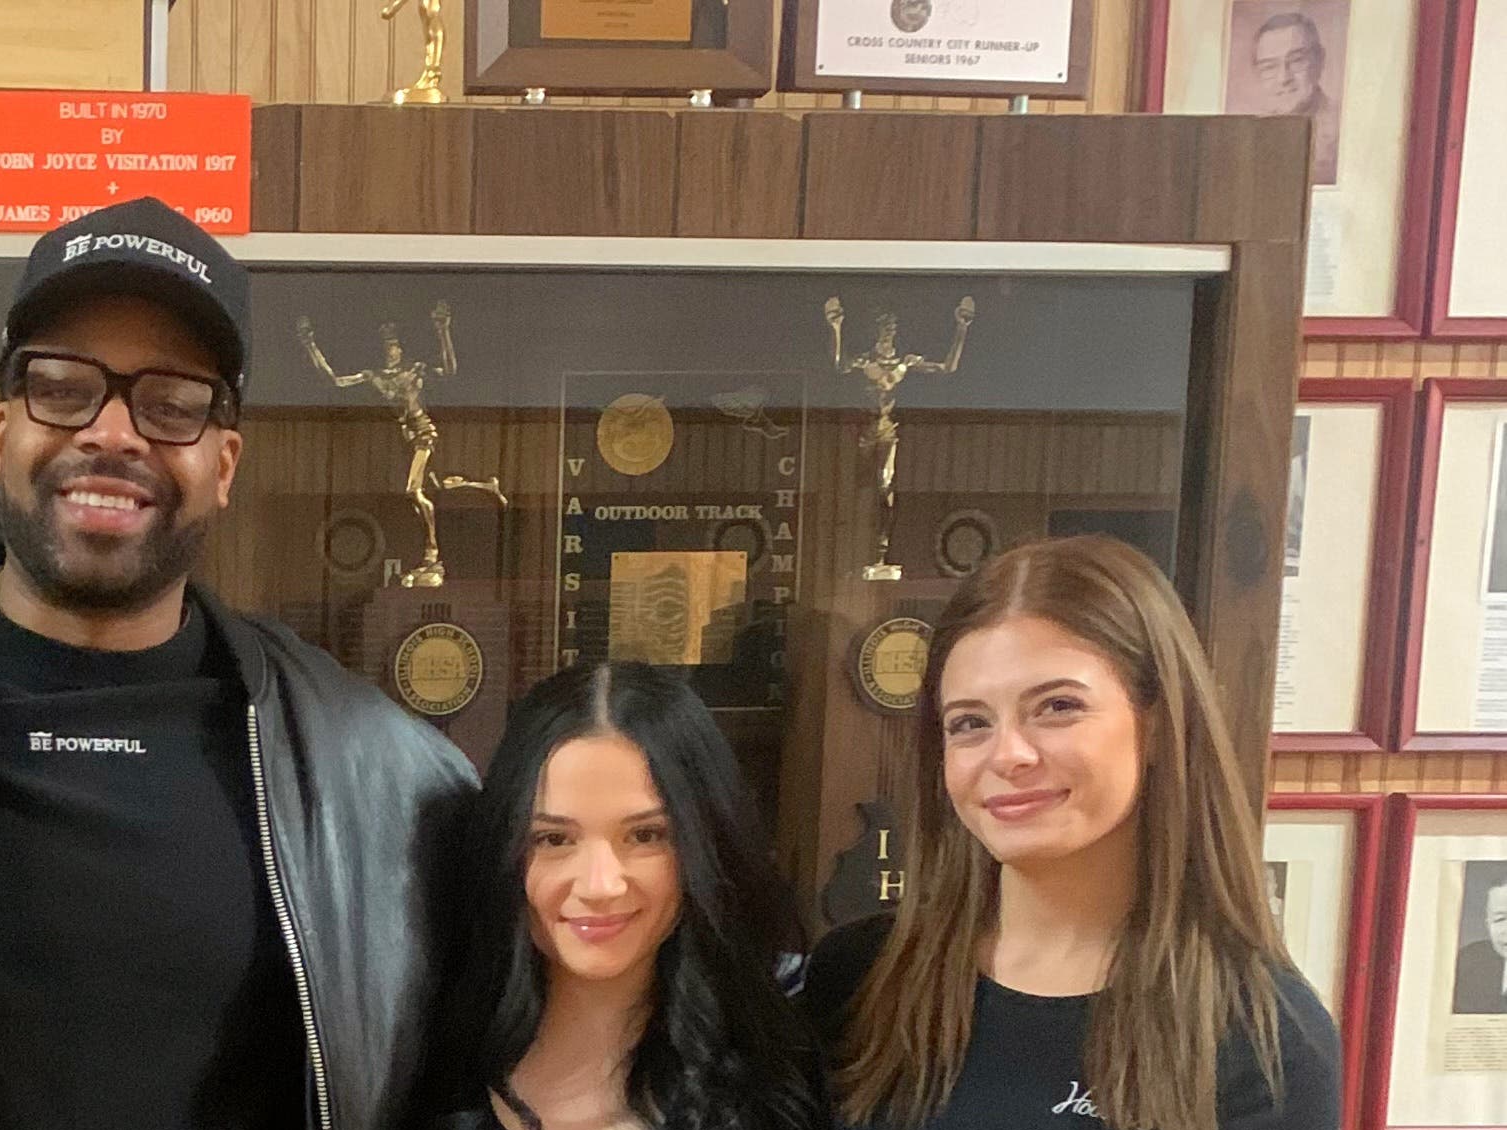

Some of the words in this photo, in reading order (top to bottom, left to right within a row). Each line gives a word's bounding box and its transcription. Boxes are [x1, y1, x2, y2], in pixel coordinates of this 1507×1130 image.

[847, 36, 884, 48] CROSS
[888, 37, 942, 49] COUNTRY
[947, 39, 970, 50] CITY
[974, 40, 1040, 52] RUNNER-UP
[904, 53, 951, 65] SENIORS
[955, 54, 981, 66] 1967
[59, 101, 108, 119] BUILT
[110, 102, 129, 119] IN
[130, 102, 168, 120] 1970
[100, 127, 124, 145] BY
[42, 153, 97, 170] JOYCE
[106, 154, 198, 171] VISITATION
[204, 155, 236, 172] 1917
[195, 207, 233, 223] 1960
[63, 239, 92, 263] BE
[92, 234, 212, 284] POWERFUL
[594, 505, 689, 520] OUTDOOR
[695, 505, 764, 521] TRACK
[30, 737, 53, 751] BE
[55, 737, 147, 754] POWERFUL
